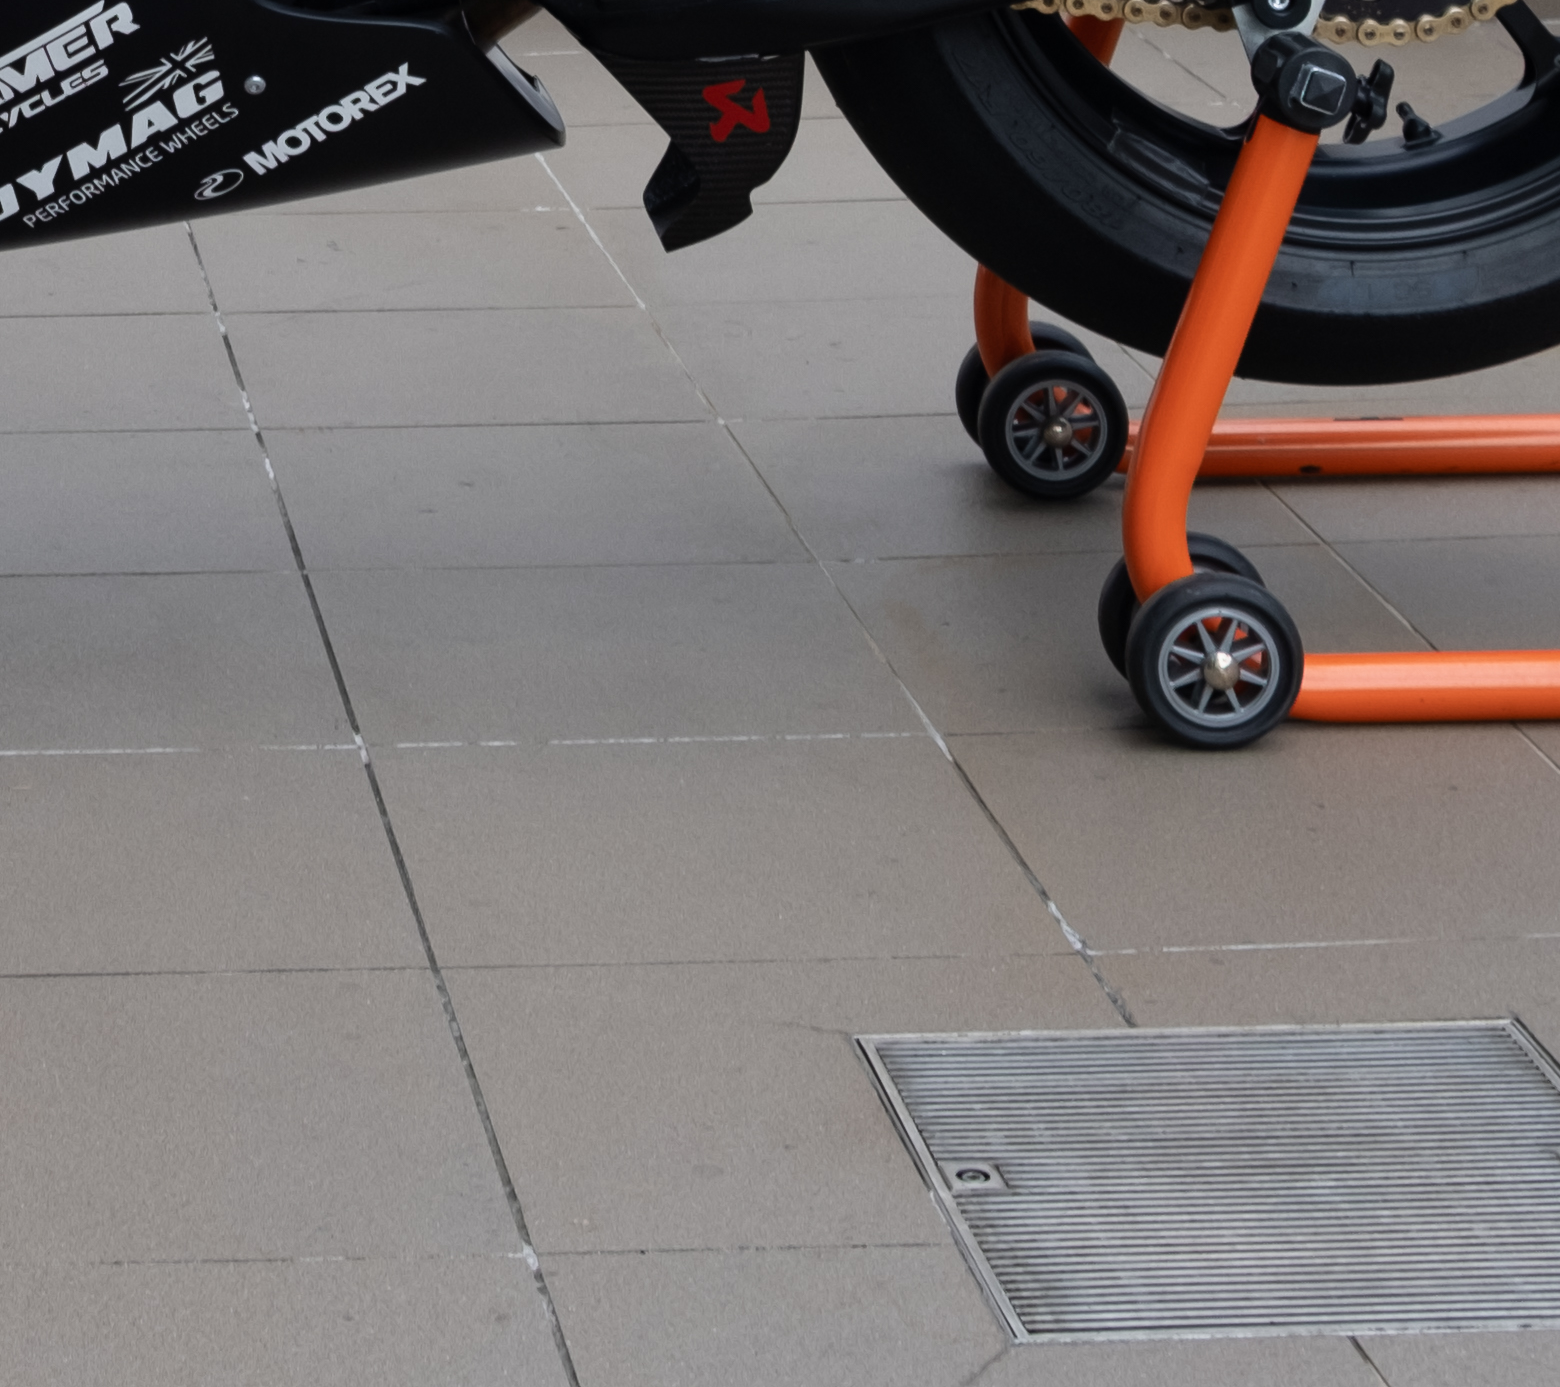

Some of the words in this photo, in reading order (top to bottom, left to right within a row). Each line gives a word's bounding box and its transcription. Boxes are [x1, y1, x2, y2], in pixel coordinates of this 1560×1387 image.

[22, 144, 163, 228] PERFORMANCE
[162, 102, 239, 155] WHEELS
[242, 62, 427, 176] MOTOREX
